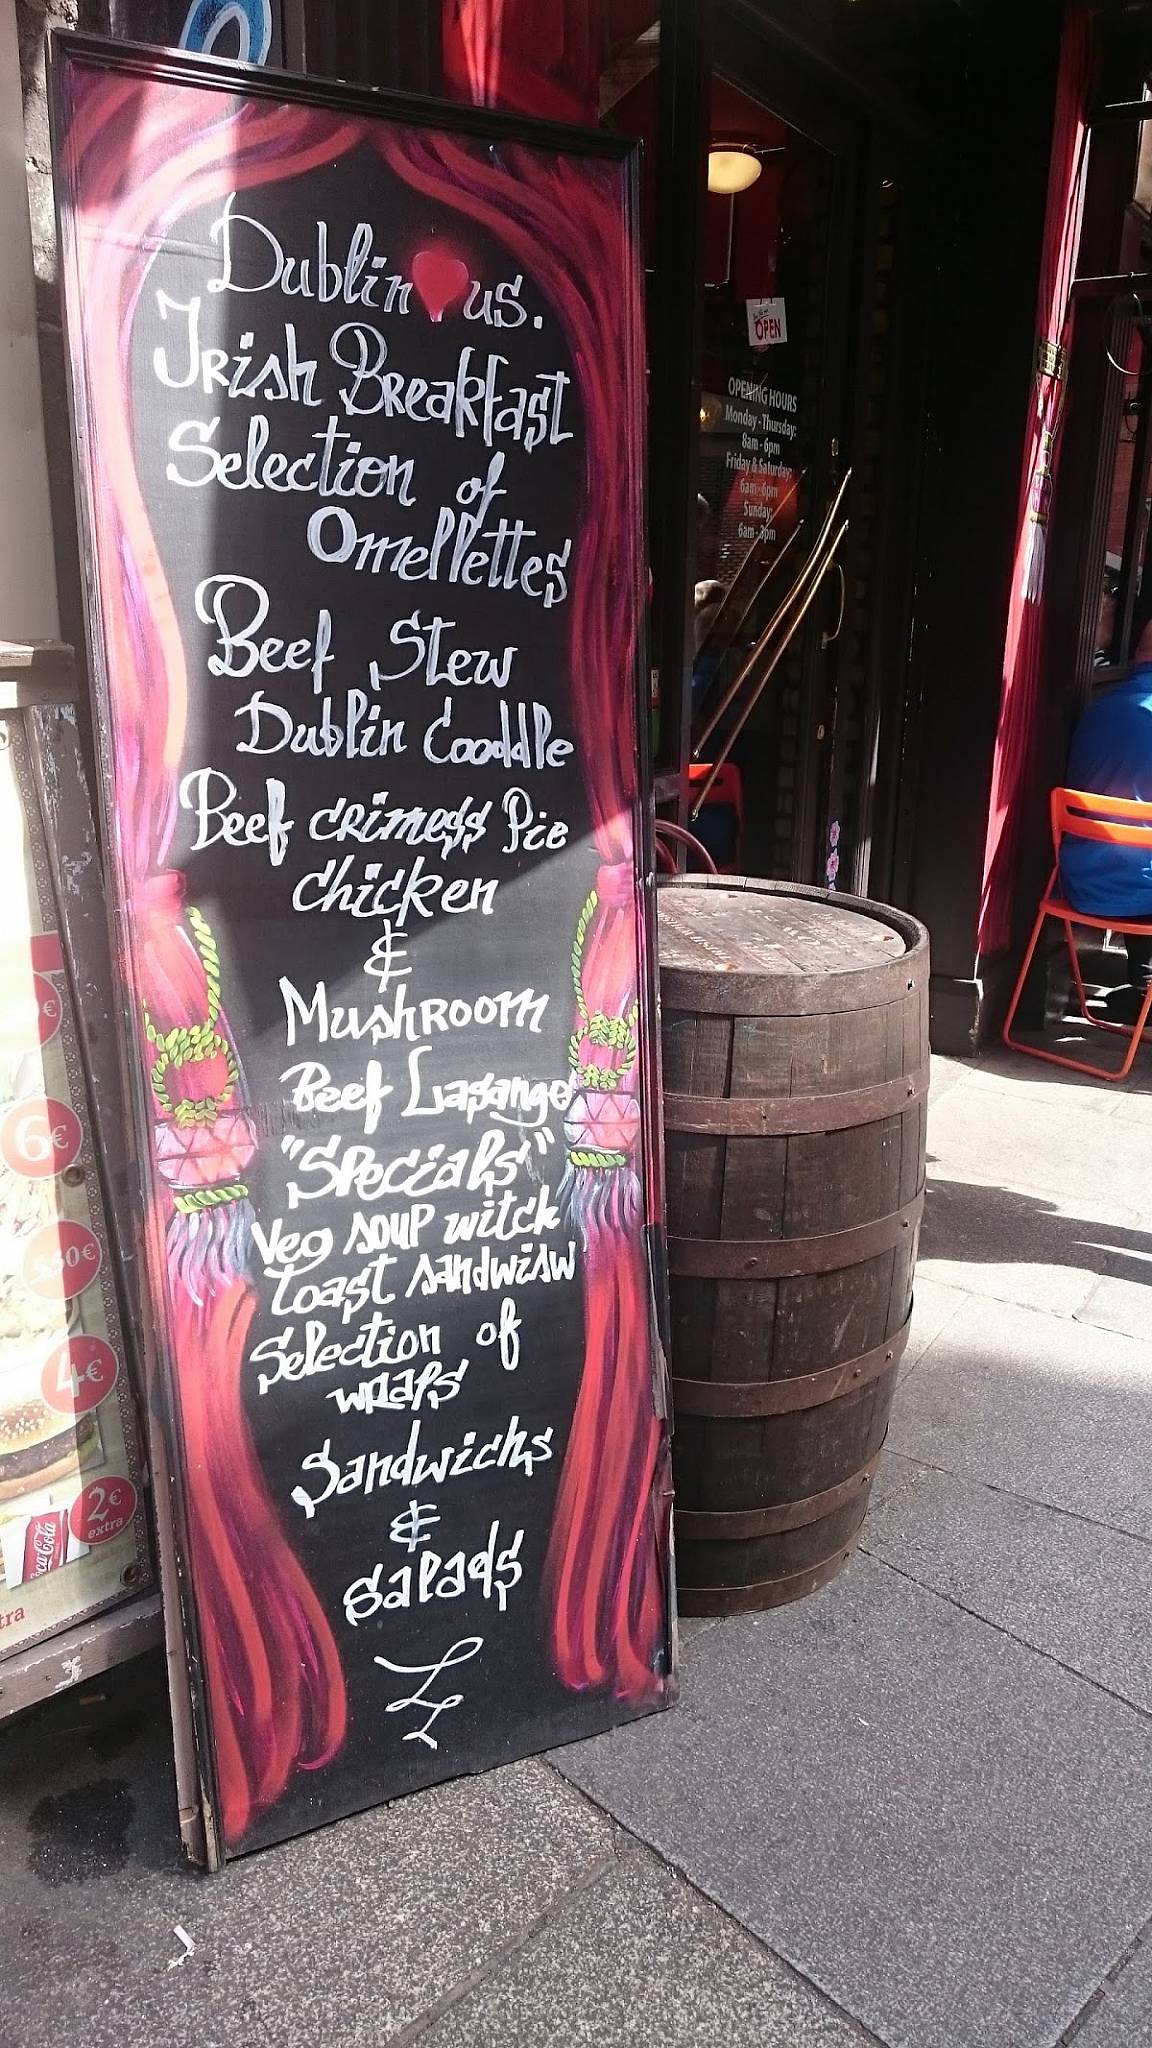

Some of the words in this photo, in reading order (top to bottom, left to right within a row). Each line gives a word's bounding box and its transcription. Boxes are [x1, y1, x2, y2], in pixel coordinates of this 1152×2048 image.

[208, 192, 412, 314] Dublin
[463, 274, 543, 329] us.
[755, 319, 781, 340] OPEN
[329, 321, 574, 453] Breakfast
[728, 376, 768, 405] OPENING
[769, 388, 798, 413] HOURS
[725, 404, 758, 431] Monday
[762, 413, 797, 440] Thursday:
[742, 432, 759, 450] 8am
[763, 437, 780, 458] 6pm
[166, 414, 417, 507] Selection
[456, 451, 506, 528] of
[726, 451, 751, 476] Friday
[759, 458, 793, 482] Saturday:
[740, 478, 757, 494] 6am
[762, 481, 778, 501] 6pm
[307, 505, 572, 608] Omellettes
[738, 522, 754, 539] 6am
[195, 574, 335, 694] Beef
[369, 609, 519, 691] Stew
[234, 690, 408, 759] Dublin
[179, 767, 295, 867] Beef
[501, 787, 569, 853] Pie
[279, 1059, 393, 1134] Beef
[251, 1218, 333, 1278] Veg
[56, 1343, 104, 1398] 4€
[250, 1312, 441, 1395] Selection
[475, 1297, 522, 1370] of
[87, 1486, 122, 1521] 2€
[87, 1517, 123, 1539] extra
